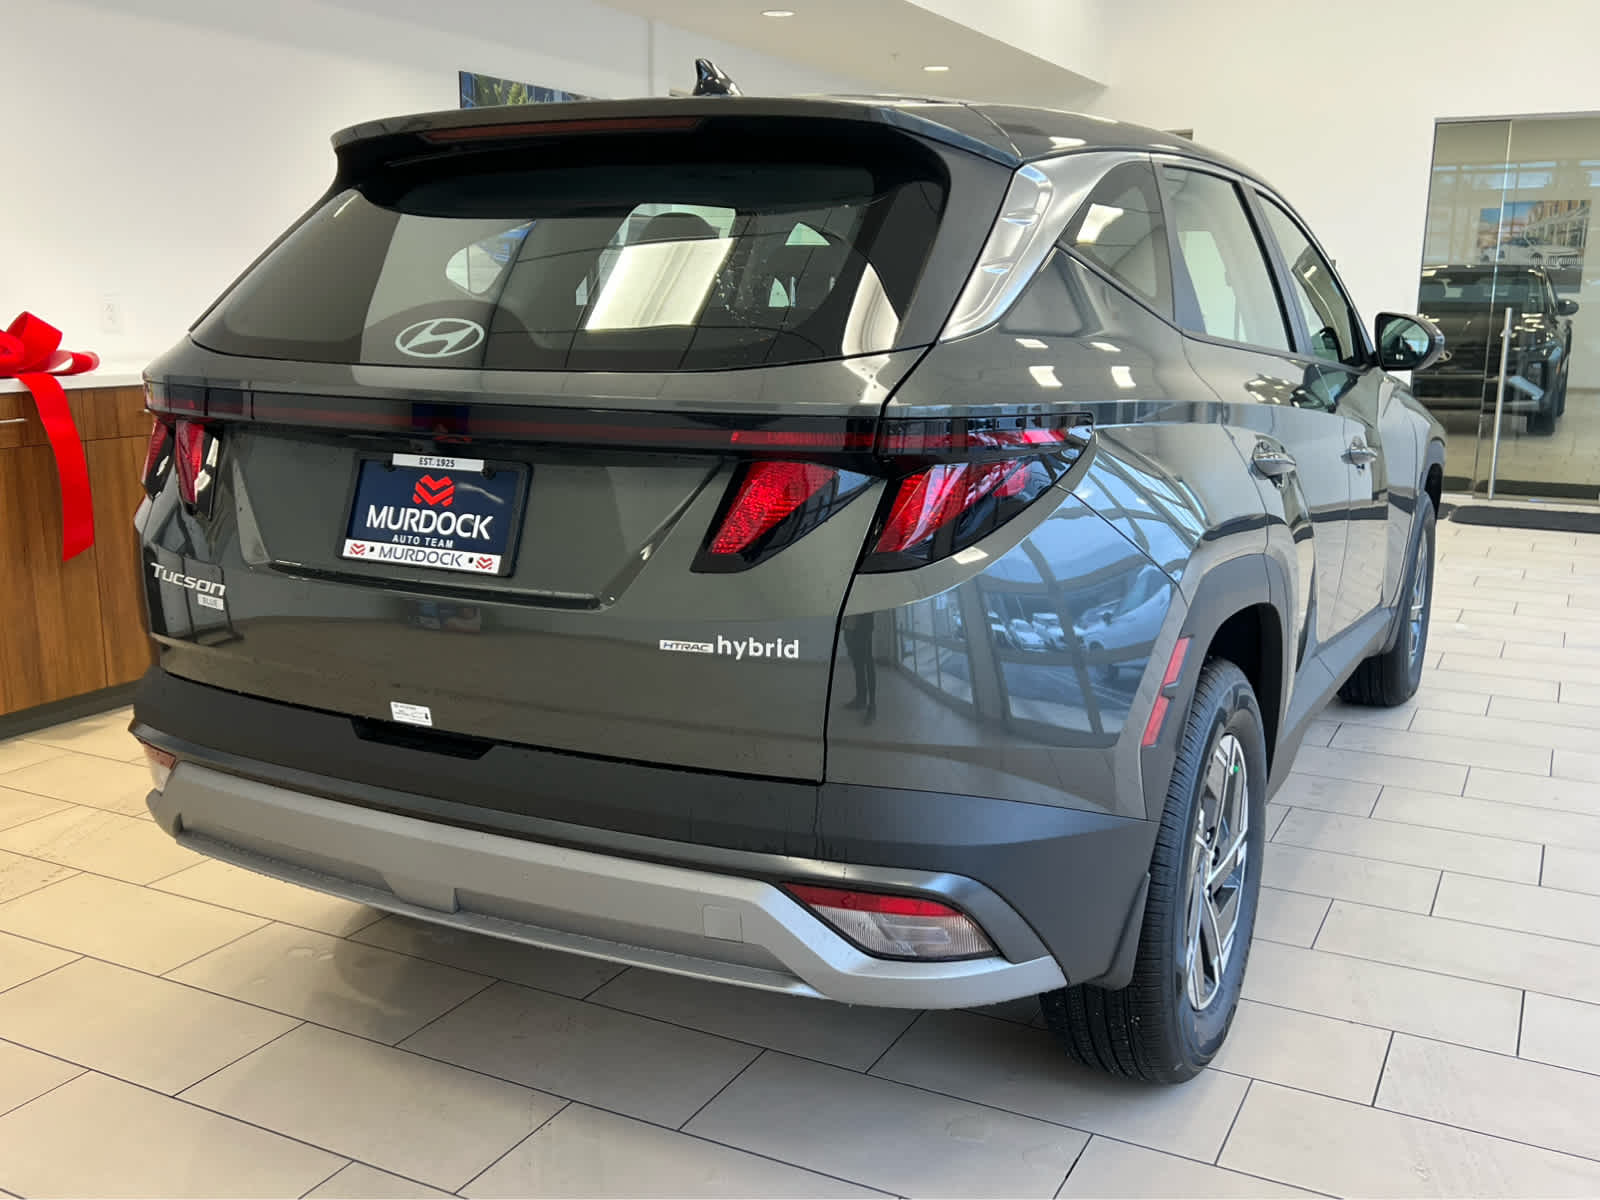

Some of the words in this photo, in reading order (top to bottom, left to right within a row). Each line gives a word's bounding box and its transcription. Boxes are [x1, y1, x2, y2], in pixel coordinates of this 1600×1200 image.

[419, 456, 435, 466] EST.
[436, 457, 456, 468] 1925
[366, 504, 494, 540] MURDOCK
[392, 534, 421, 545] AUTO
[425, 537, 454, 549] TEAM
[378, 545, 463, 567] MURDOCK
[717, 635, 799, 660] hybrid
